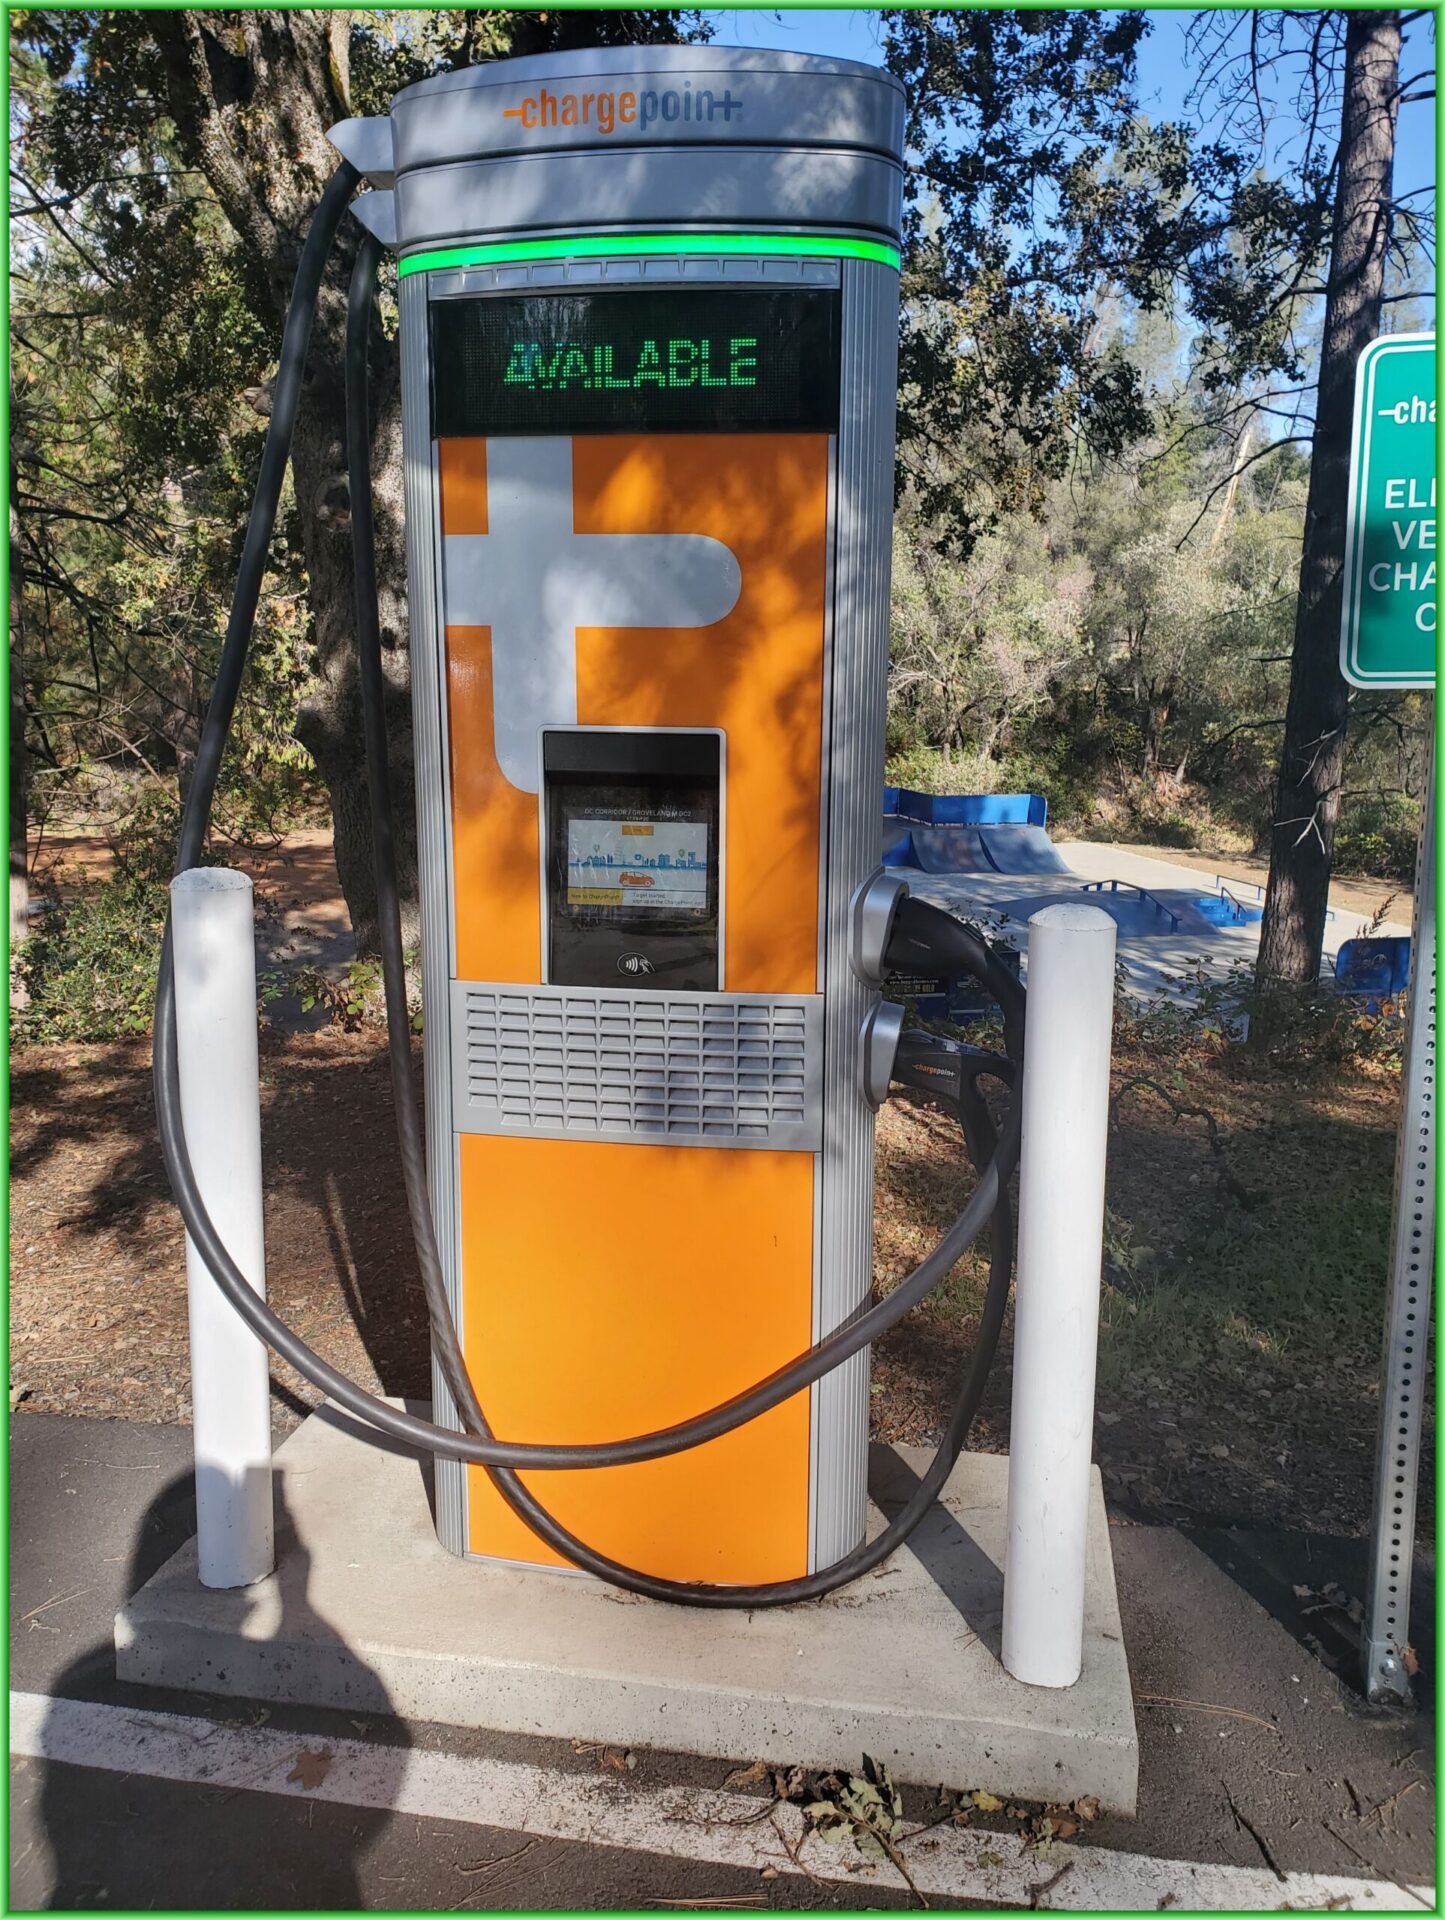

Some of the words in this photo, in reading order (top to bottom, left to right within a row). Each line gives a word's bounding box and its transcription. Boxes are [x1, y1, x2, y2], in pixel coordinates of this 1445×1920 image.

[503, 338, 758, 389] AVAILABLE
[1385, 478, 1436, 508] EL
[1392, 519, 1436, 550] VE
[1368, 561, 1436, 591] CHA
[595, 808, 627, 816] CORRIDOR
